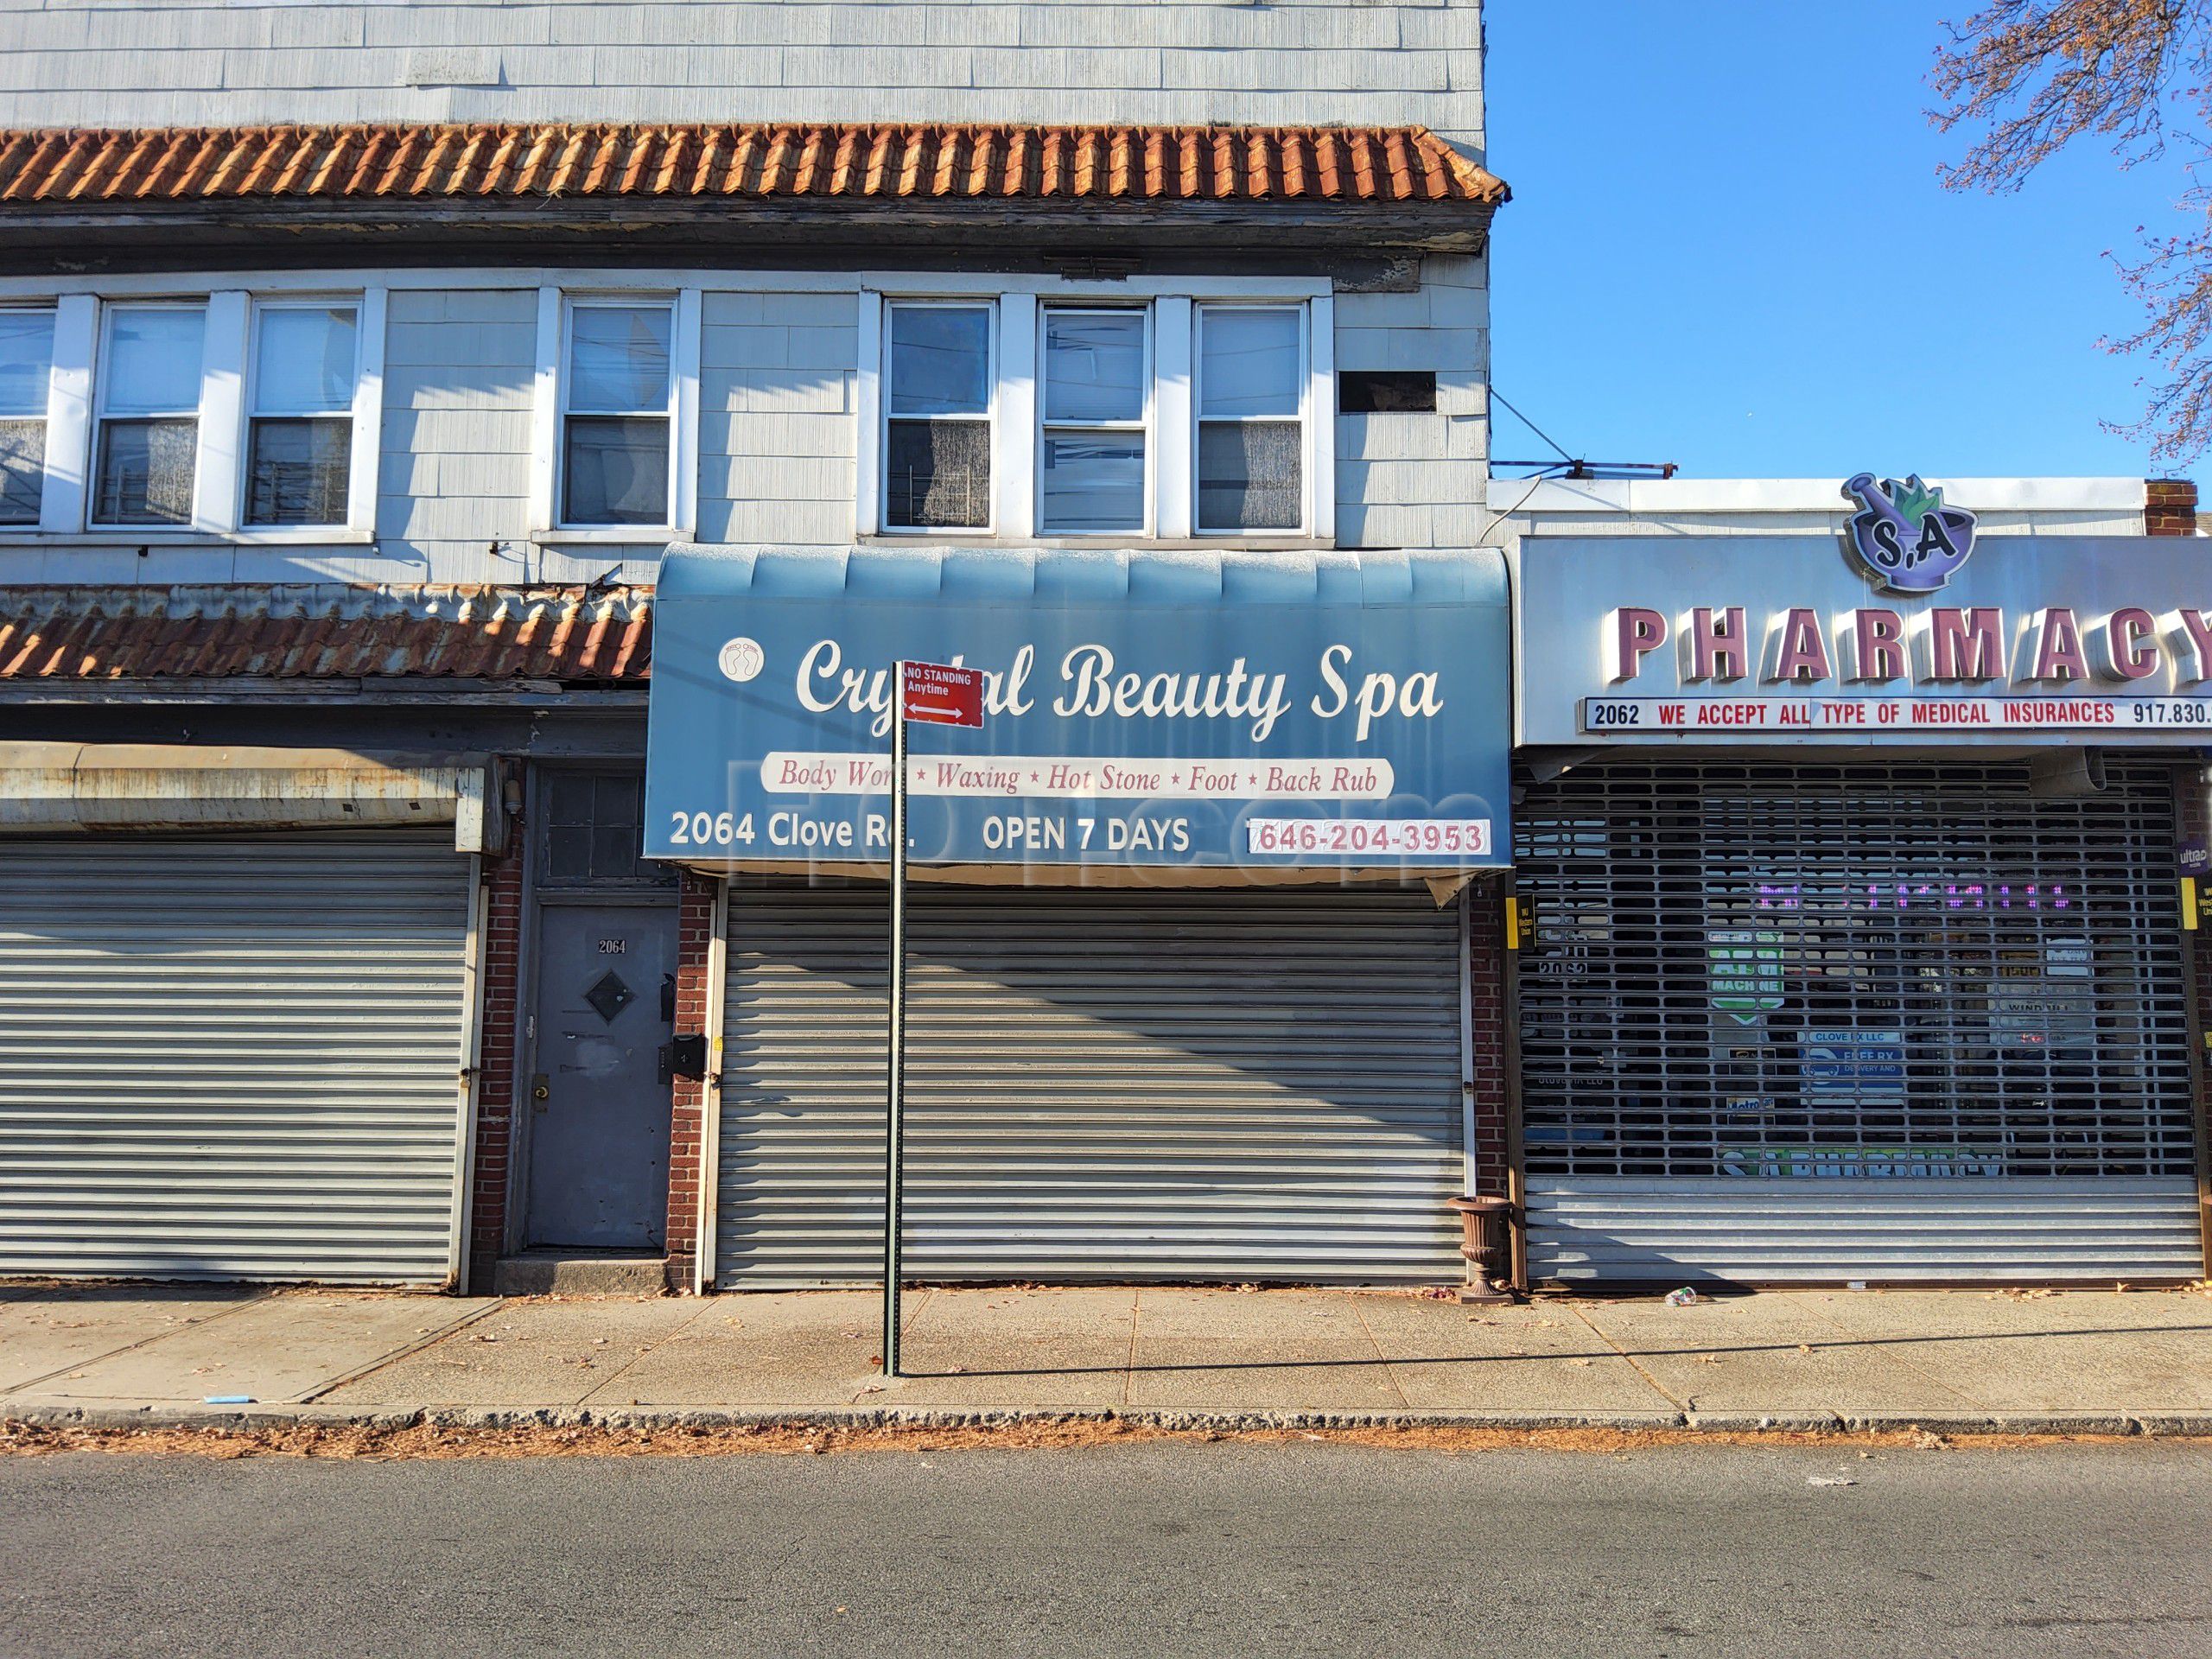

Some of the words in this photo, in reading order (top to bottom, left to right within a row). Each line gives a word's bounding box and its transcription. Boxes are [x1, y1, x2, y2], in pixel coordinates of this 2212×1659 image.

[1611, 607, 2212, 682] PHARMACY
[907, 666, 922, 679] NO
[924, 669, 971, 685] STANDING
[907, 680, 949, 696] Anytime
[797, 639, 1034, 737] Cryal
[1053, 644, 1291, 742] Beauty
[1311, 644, 1444, 742] Spa
[1594, 703, 1639, 726] 2062
[1658, 703, 1686, 726] WE
[1697, 703, 1767, 726] ACCEPT
[1778, 703, 1811, 726] ALL
[1822, 703, 1866, 725] TYPE
[1878, 703, 1901, 725] OF
[1911, 702, 1991, 725] MEDICAL
[2003, 702, 2115, 724] INSURANCES
[779, 759, 836, 791] Body
[849, 760, 893, 787] Wor
[937, 762, 1020, 795] Waxing
[1047, 764, 1092, 790] Hot
[1099, 765, 1160, 791] Stone
[1188, 766, 1237, 791] Foot
[1265, 766, 1321, 792] Back
[1332, 766, 1377, 792] Rub
[670, 810, 755, 845] 2064
[768, 811, 853, 847] Clove
[866, 813, 915, 848] R.
[983, 815, 1065, 850] OPEN
[1077, 817, 1096, 850] 7
[1108, 817, 1190, 851] DAYS
[1260, 824, 1482, 851] 646-204-3953
[599, 939, 626, 954] 2064
[1712, 980, 1779, 992] MACHNE
[1815, 1033, 1847, 1041] CLOVE
[1866, 1033, 1885, 1041] LLC
